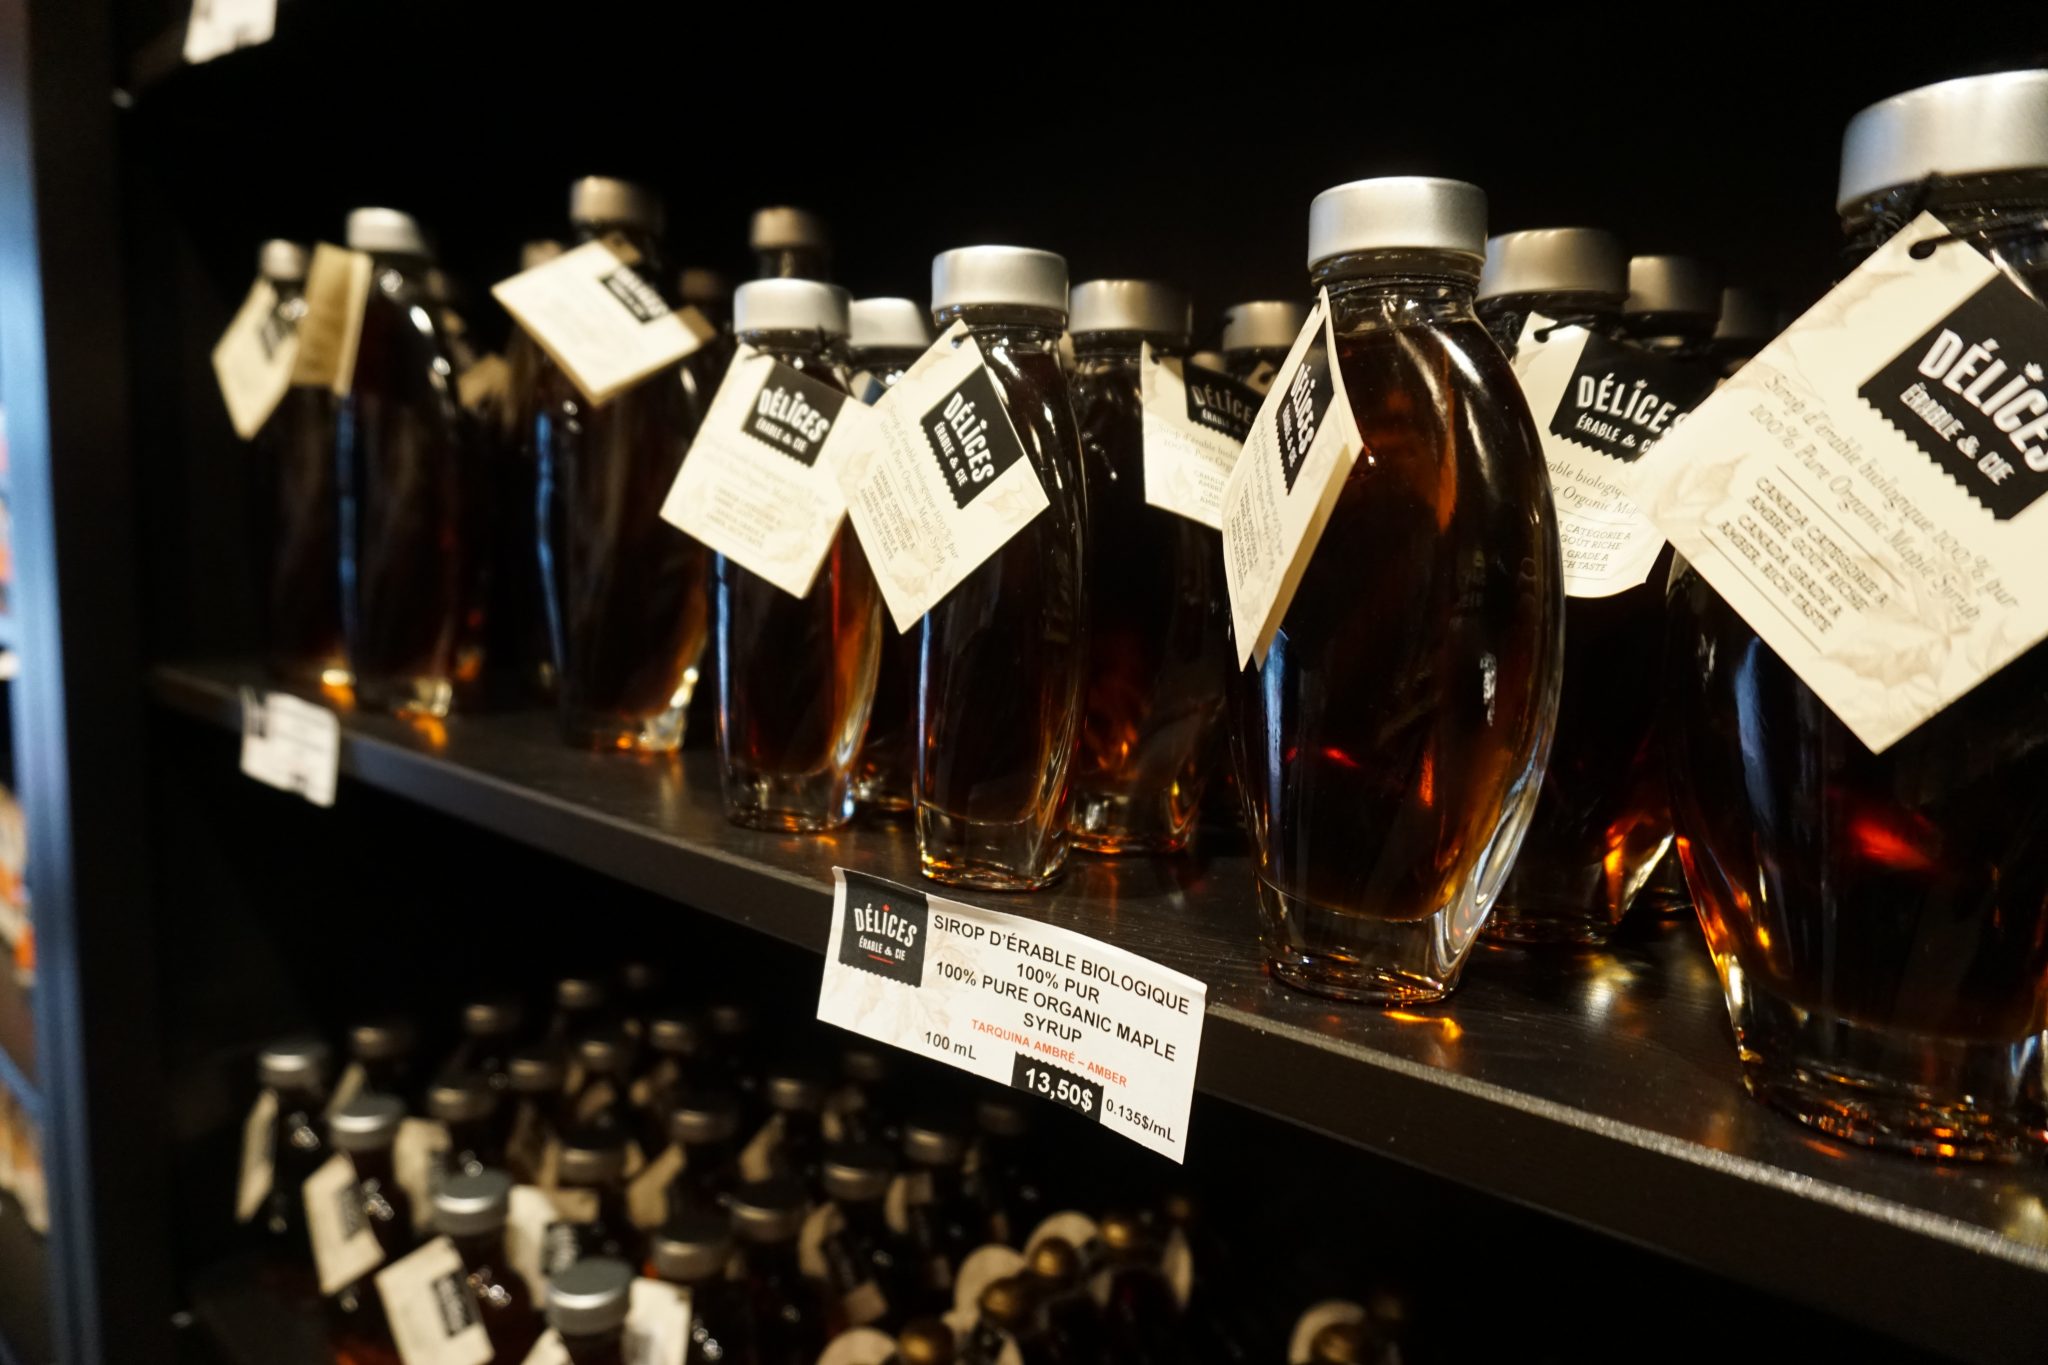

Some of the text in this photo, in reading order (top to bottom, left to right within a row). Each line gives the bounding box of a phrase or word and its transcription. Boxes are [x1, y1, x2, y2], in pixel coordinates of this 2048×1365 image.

[757, 386, 830, 443] DÉLICES
[1190, 383, 1253, 425] DÉLICE
[1290, 362, 1316, 455] DÉLICES
[1575, 411, 1622, 443] ÉRABLE
[1621, 433, 1636, 448] &
[934, 420, 969, 488] ÉRABLE & CIE
[943, 391, 996, 484] DÉLICES
[1562, 485, 1611, 512] Organic
[1756, 475, 1809, 528] CANADA
[1738, 512, 1791, 567] CANADA
[854, 903, 918, 948] DÉLICES
[858, 935, 907, 961] ÉRABLE & CIE
[934, 914, 985, 940] SIROP
[1081, 959, 1190, 1016] BIOLOGIQUE
[1017, 963, 1100, 1005] 100% PUR
[936, 961, 1177, 1062] 100% PURE ORGANIC MAPLE
[1023, 1012, 1083, 1043] SYRUP
[925, 1030, 977, 1061] 100 mL
[971, 1018, 1030, 1048] TARQUINA
[1034, 1039, 1076, 1065] AMBRÉ
[1087, 1061, 1128, 1088] AMBER
[1025, 1067, 1176, 1144] 13,50$ 0.135$/mL
